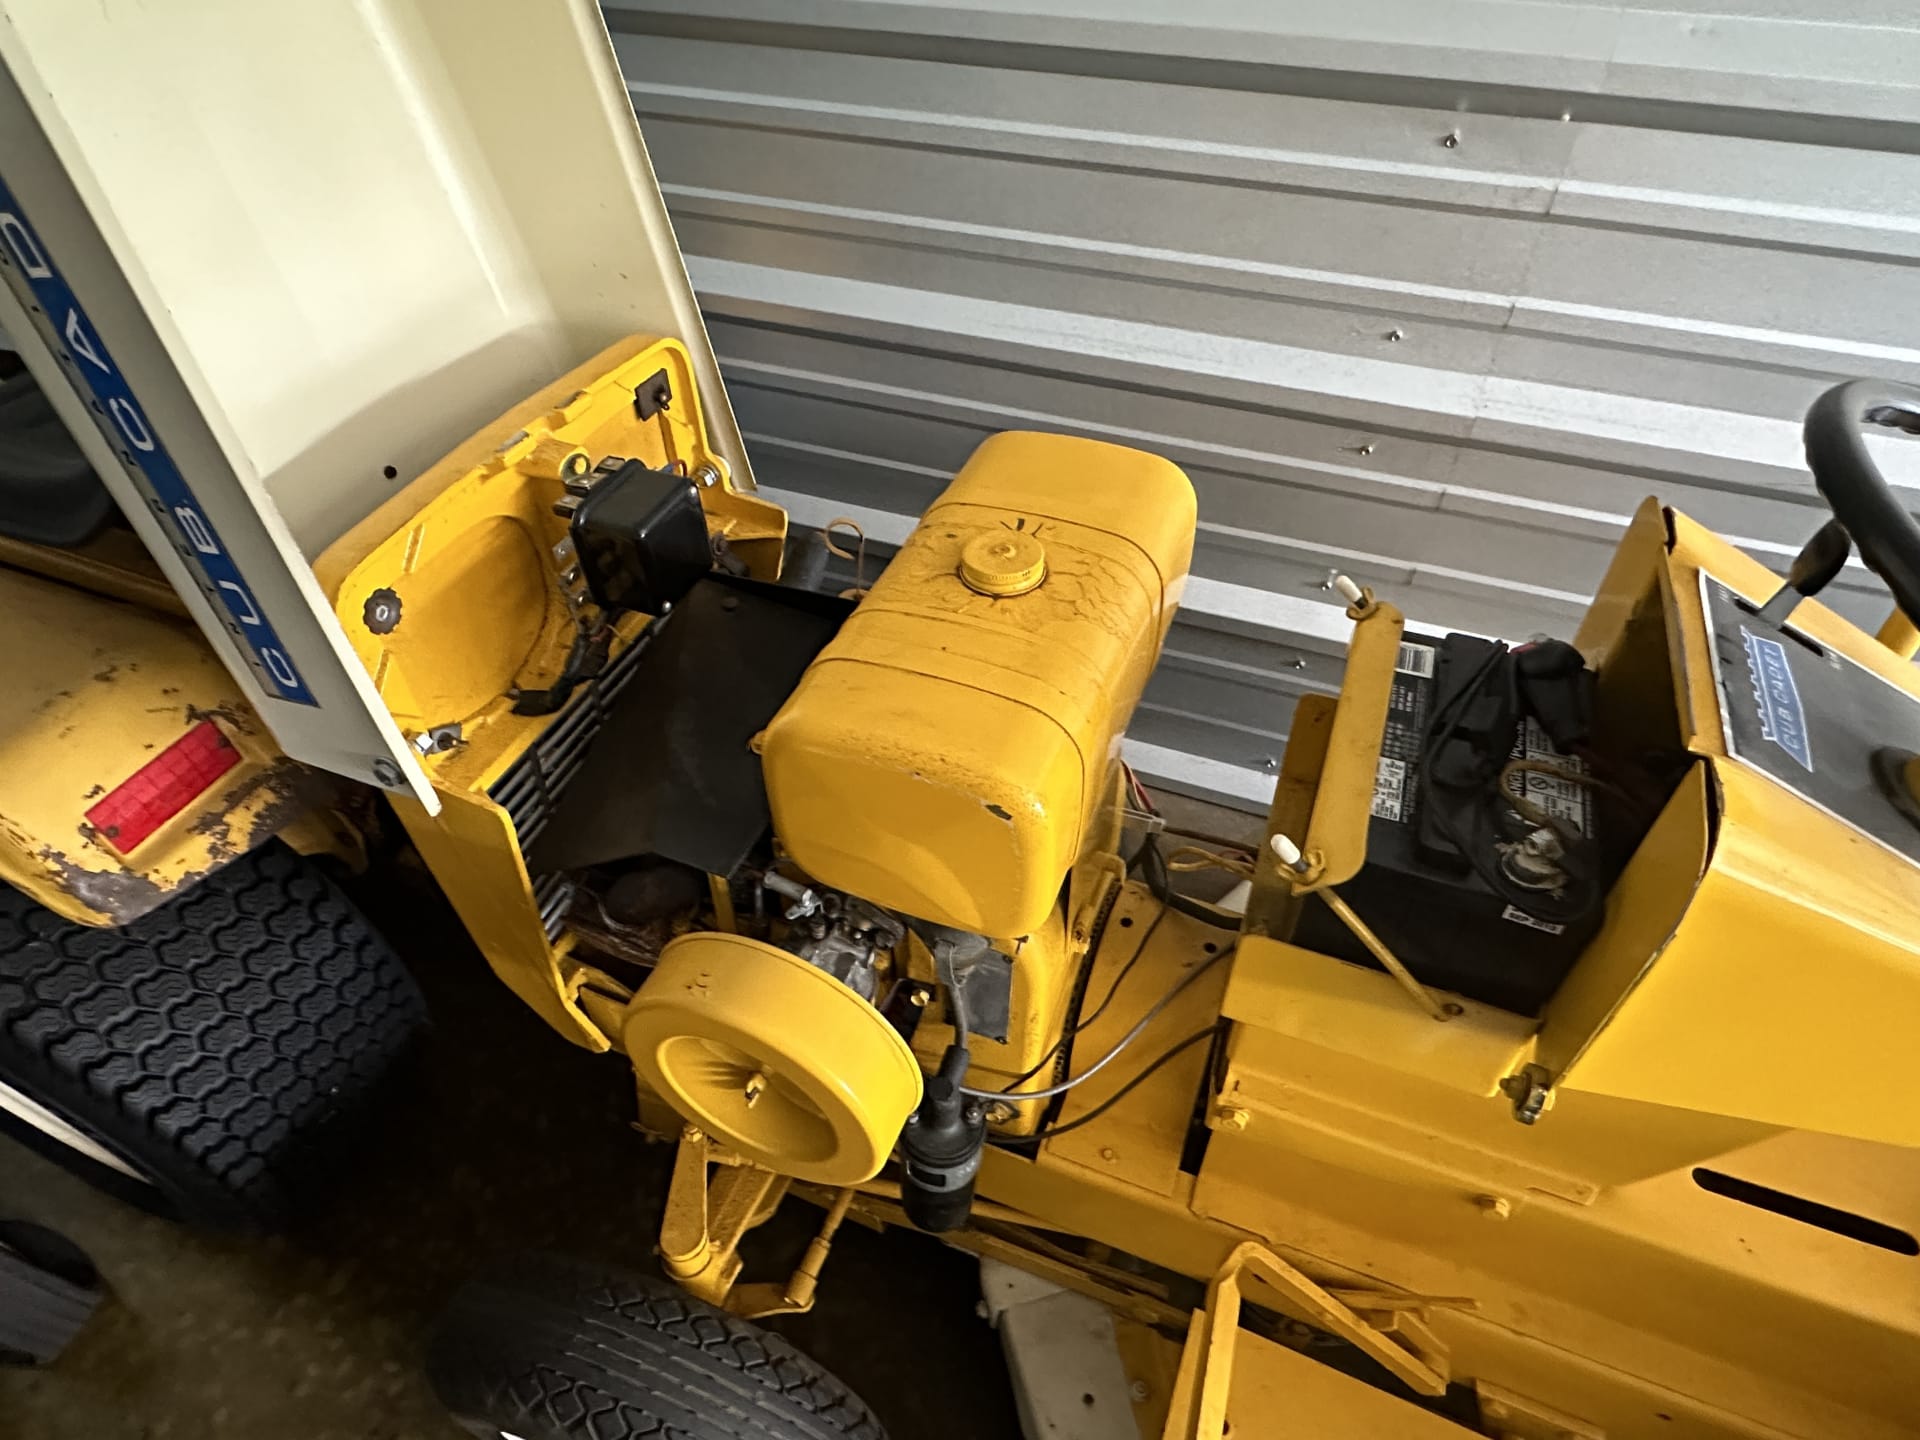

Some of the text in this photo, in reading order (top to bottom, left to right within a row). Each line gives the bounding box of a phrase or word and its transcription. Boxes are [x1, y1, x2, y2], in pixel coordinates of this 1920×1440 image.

[174, 505, 298, 688] CUB
[1763, 645, 1801, 750] CUB CADET
